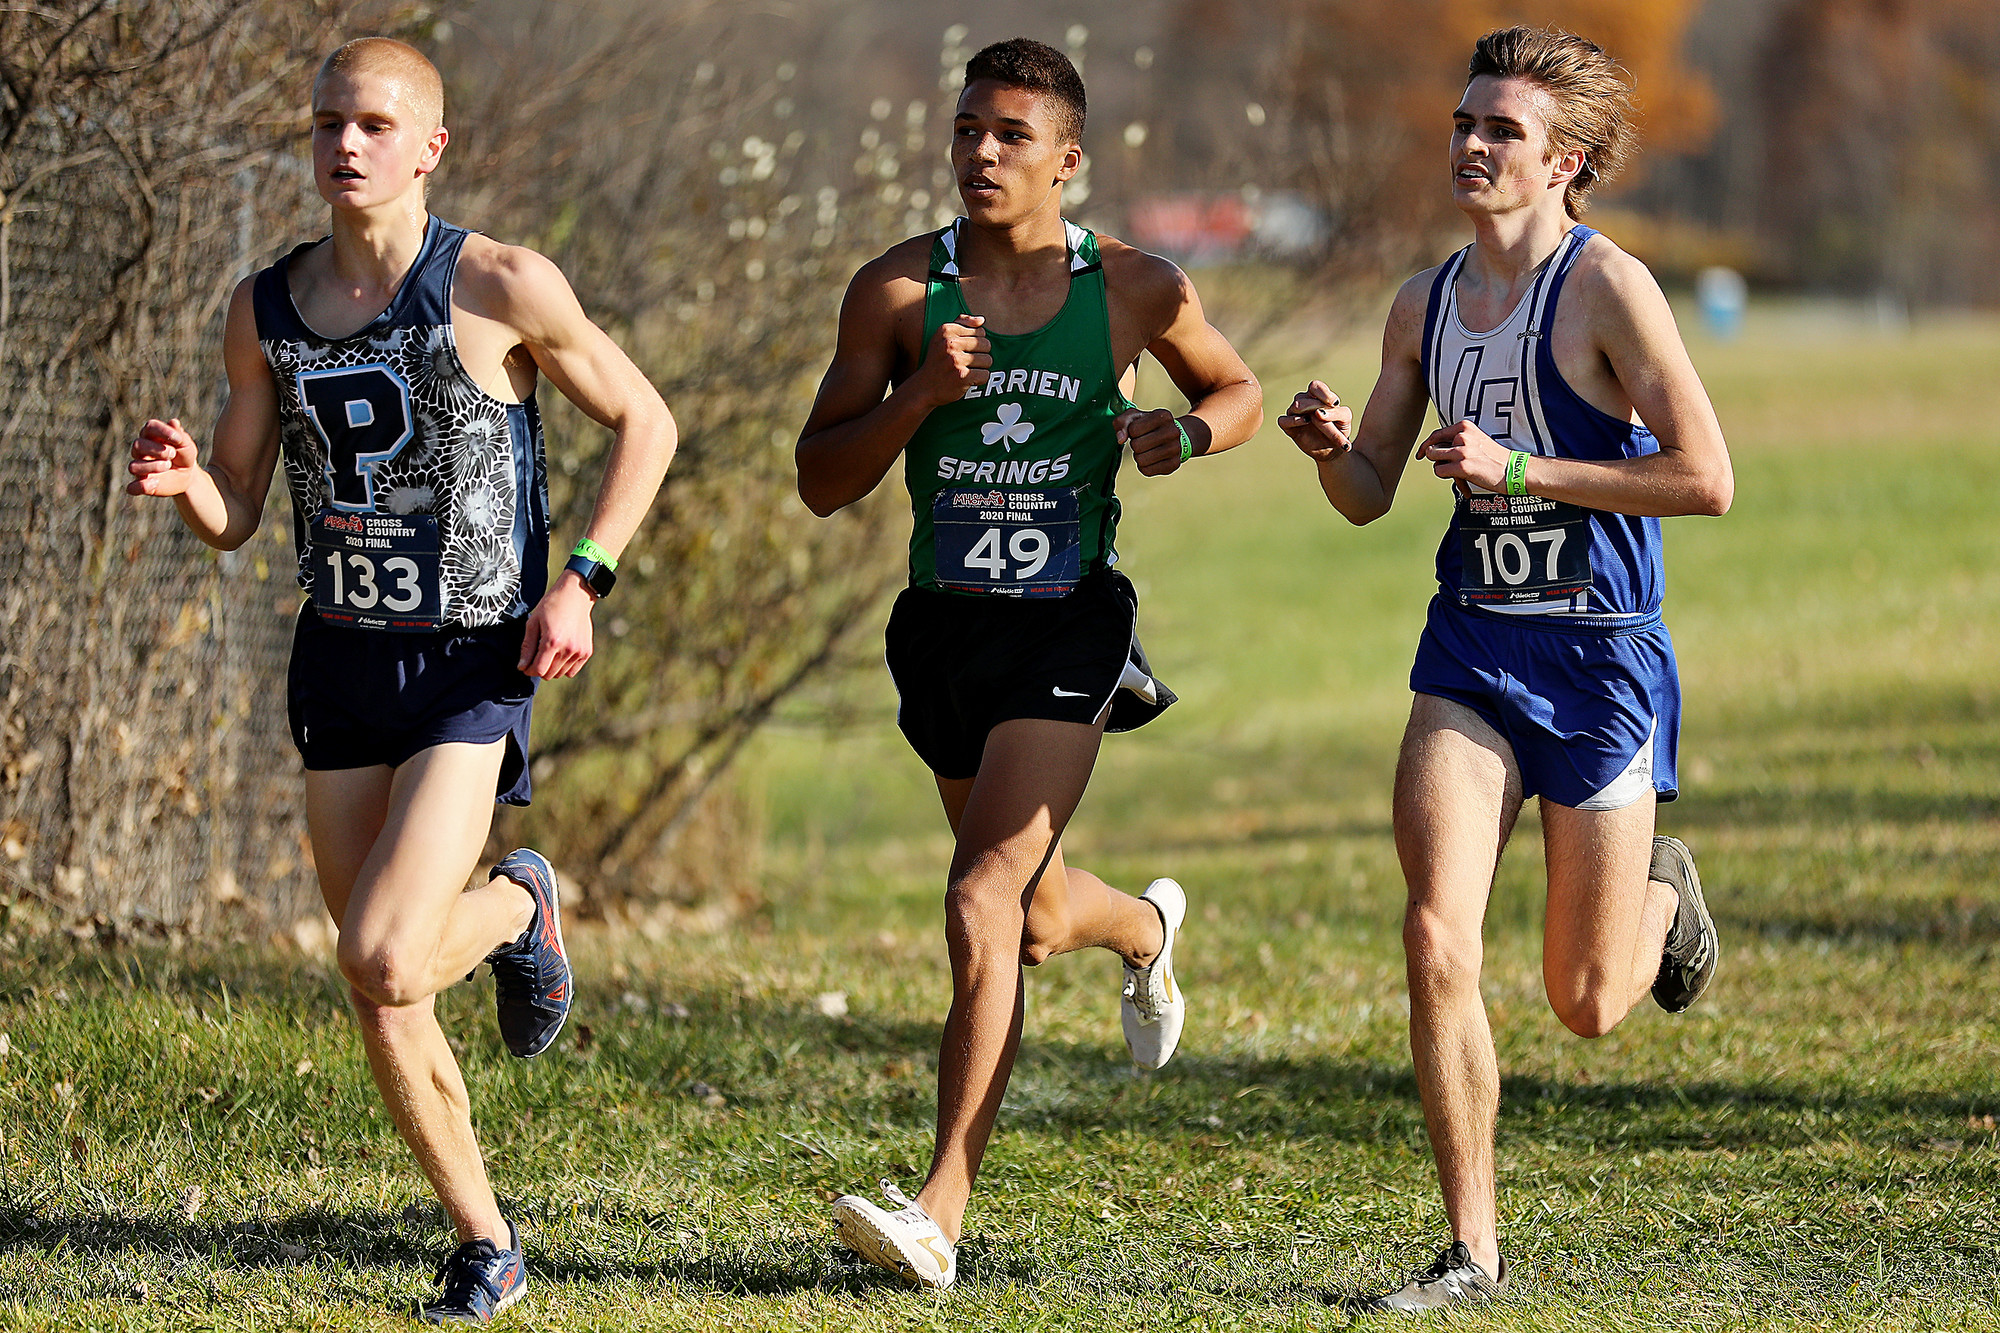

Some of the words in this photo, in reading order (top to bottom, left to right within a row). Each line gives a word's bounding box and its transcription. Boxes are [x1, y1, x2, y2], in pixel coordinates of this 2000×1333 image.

[964, 369, 1081, 403] ERRIEN
[296, 362, 414, 512] P
[937, 453, 1072, 485] SPRINGS
[1008, 493, 1045, 502] CROSS
[1510, 495, 1543, 505] CROSS
[1009, 501, 1058, 510] COUNTRY
[1511, 502, 1557, 514] COUNTRY
[979, 511, 1004, 520] 2020
[1006, 512, 1034, 521] FINAL
[1490, 516, 1510, 526] 2020
[1510, 515, 1536, 525] FINAL
[366, 518, 402, 527] CROSS
[367, 527, 417, 537] COUNTRY
[345, 535, 363, 548] 2020
[365, 538, 392, 548] FINAL
[964, 528, 1050, 580] 49
[1475, 528, 1567, 585] 107
[327, 551, 423, 612] 133
